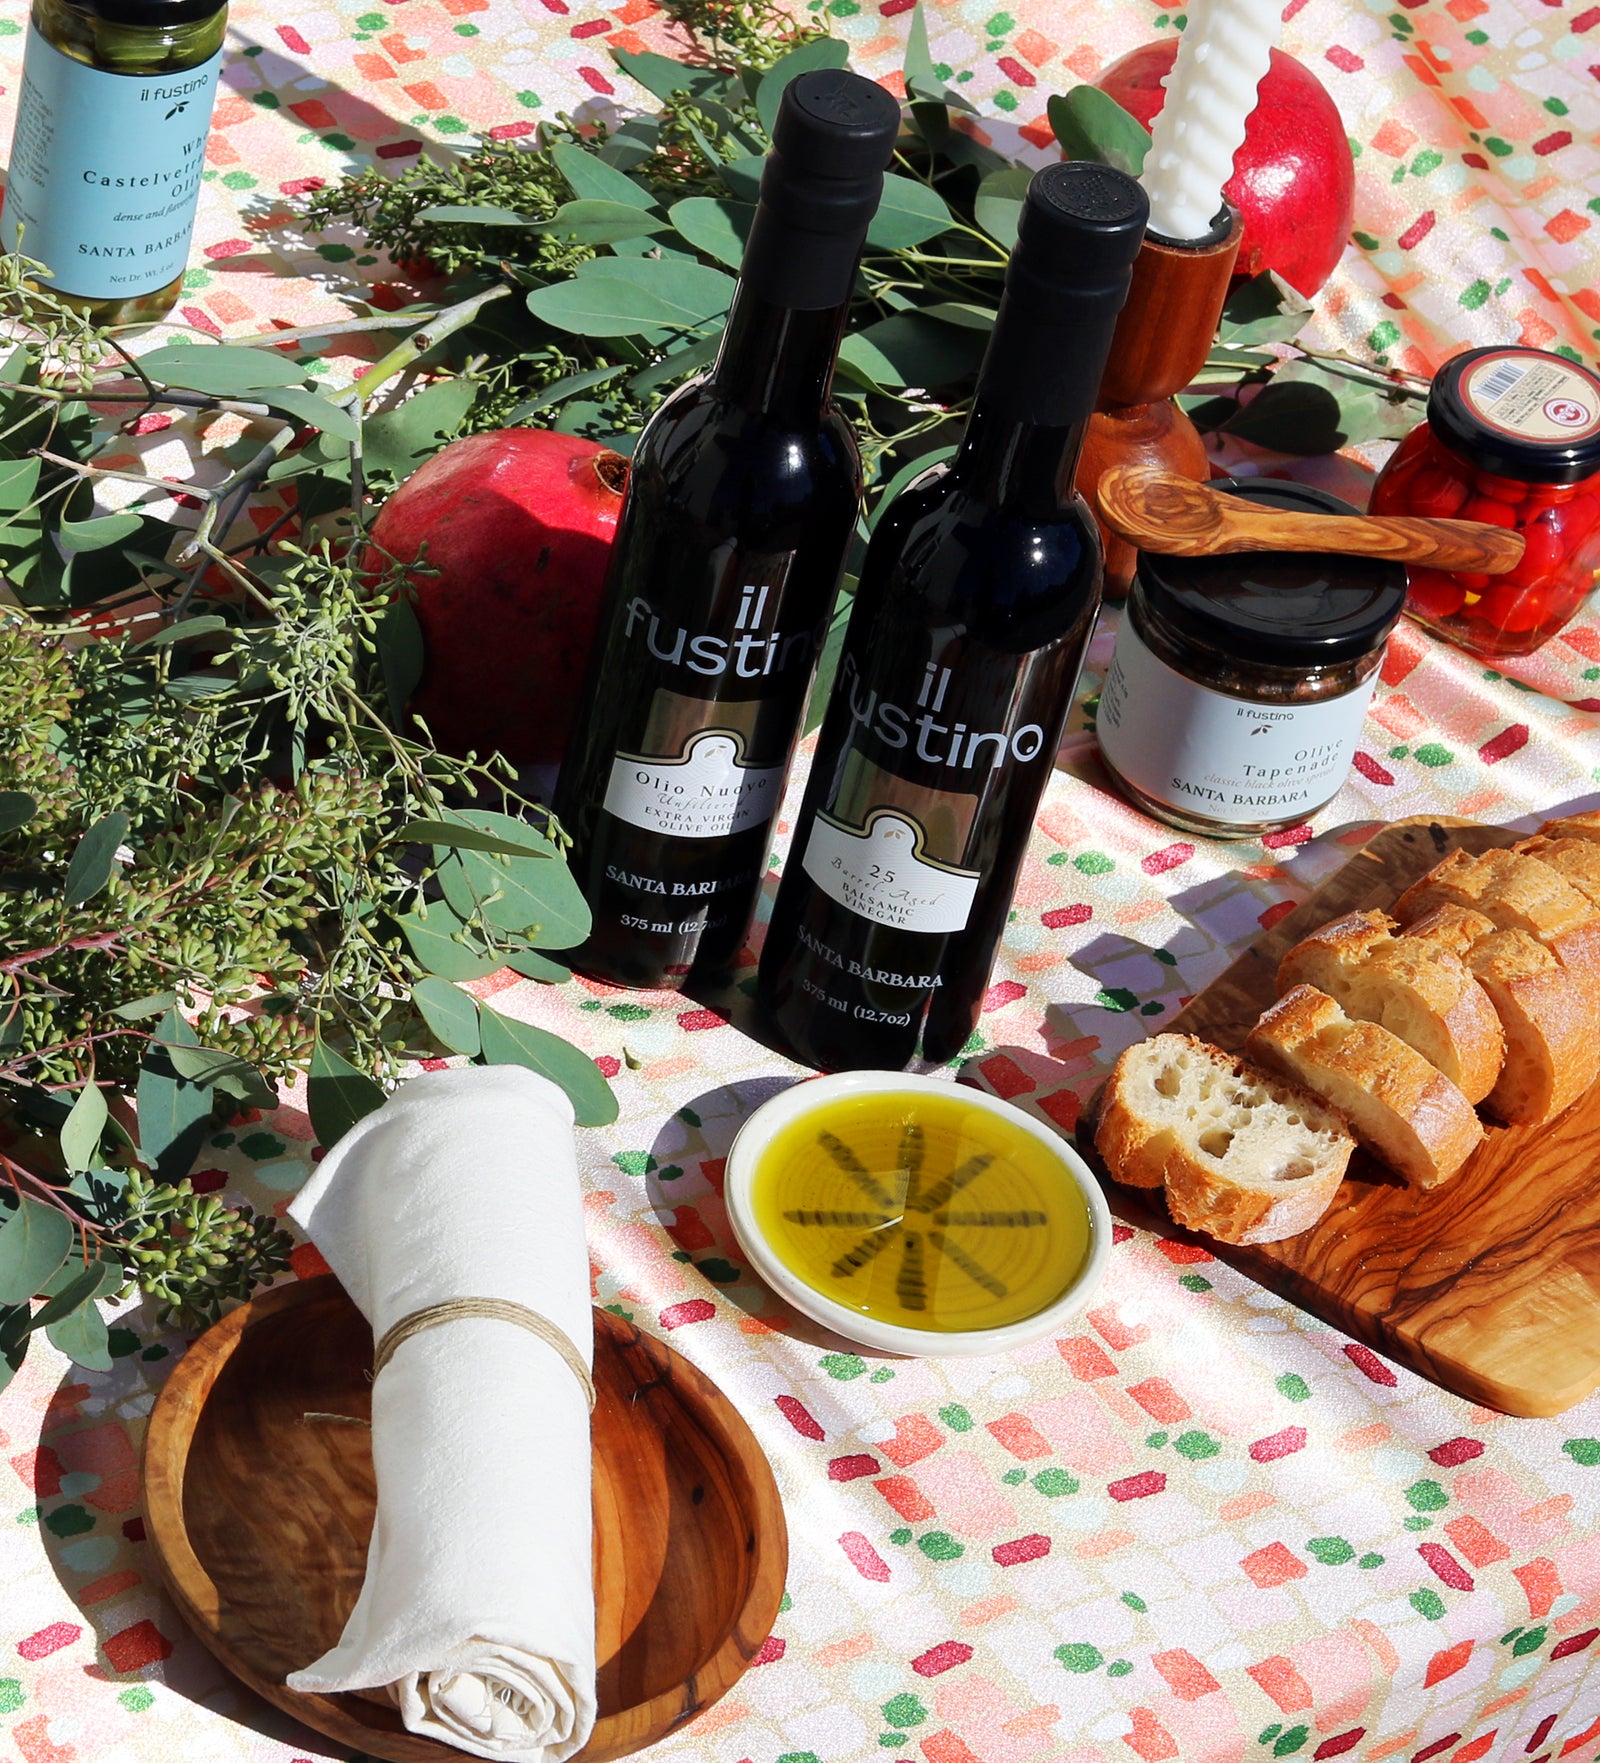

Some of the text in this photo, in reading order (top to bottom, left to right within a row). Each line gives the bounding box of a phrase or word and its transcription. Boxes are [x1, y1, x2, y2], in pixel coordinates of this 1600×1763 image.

[140, 74, 209, 101] il fustino
[113, 212, 143, 222] dense
[145, 207, 165, 220] and
[78, 243, 136, 257] SANTA
[109, 275, 126, 283] Net
[734, 585, 769, 629] il
[916, 661, 952, 712] il
[838, 651, 1044, 769] fustino
[1236, 707, 1294, 721] il fustino
[1294, 739, 1343, 762] Olive
[1243, 752, 1339, 780] Tapenade
[636, 771, 767, 797] Olio Nuovo
[1171, 777, 1308, 806] SANTA BARBARA
[1204, 773, 1240, 788] classic
[1244, 778, 1276, 790] black
[1277, 777, 1305, 788] olive
[644, 806, 750, 823] EXTRA VIRGIN
[658, 820, 703, 832] OLIVE
[605, 865, 667, 895] SANTA
[869, 864, 896, 883] 25
[842, 882, 915, 917] BALSAMIC
[844, 894, 907, 925] VINEGAR
[620, 914, 648, 930] 375
[650, 922, 673, 933] ml
[797, 925, 944, 988] SANTA BARBARA
[802, 979, 911, 1027] 375 ml (12.7oz)
